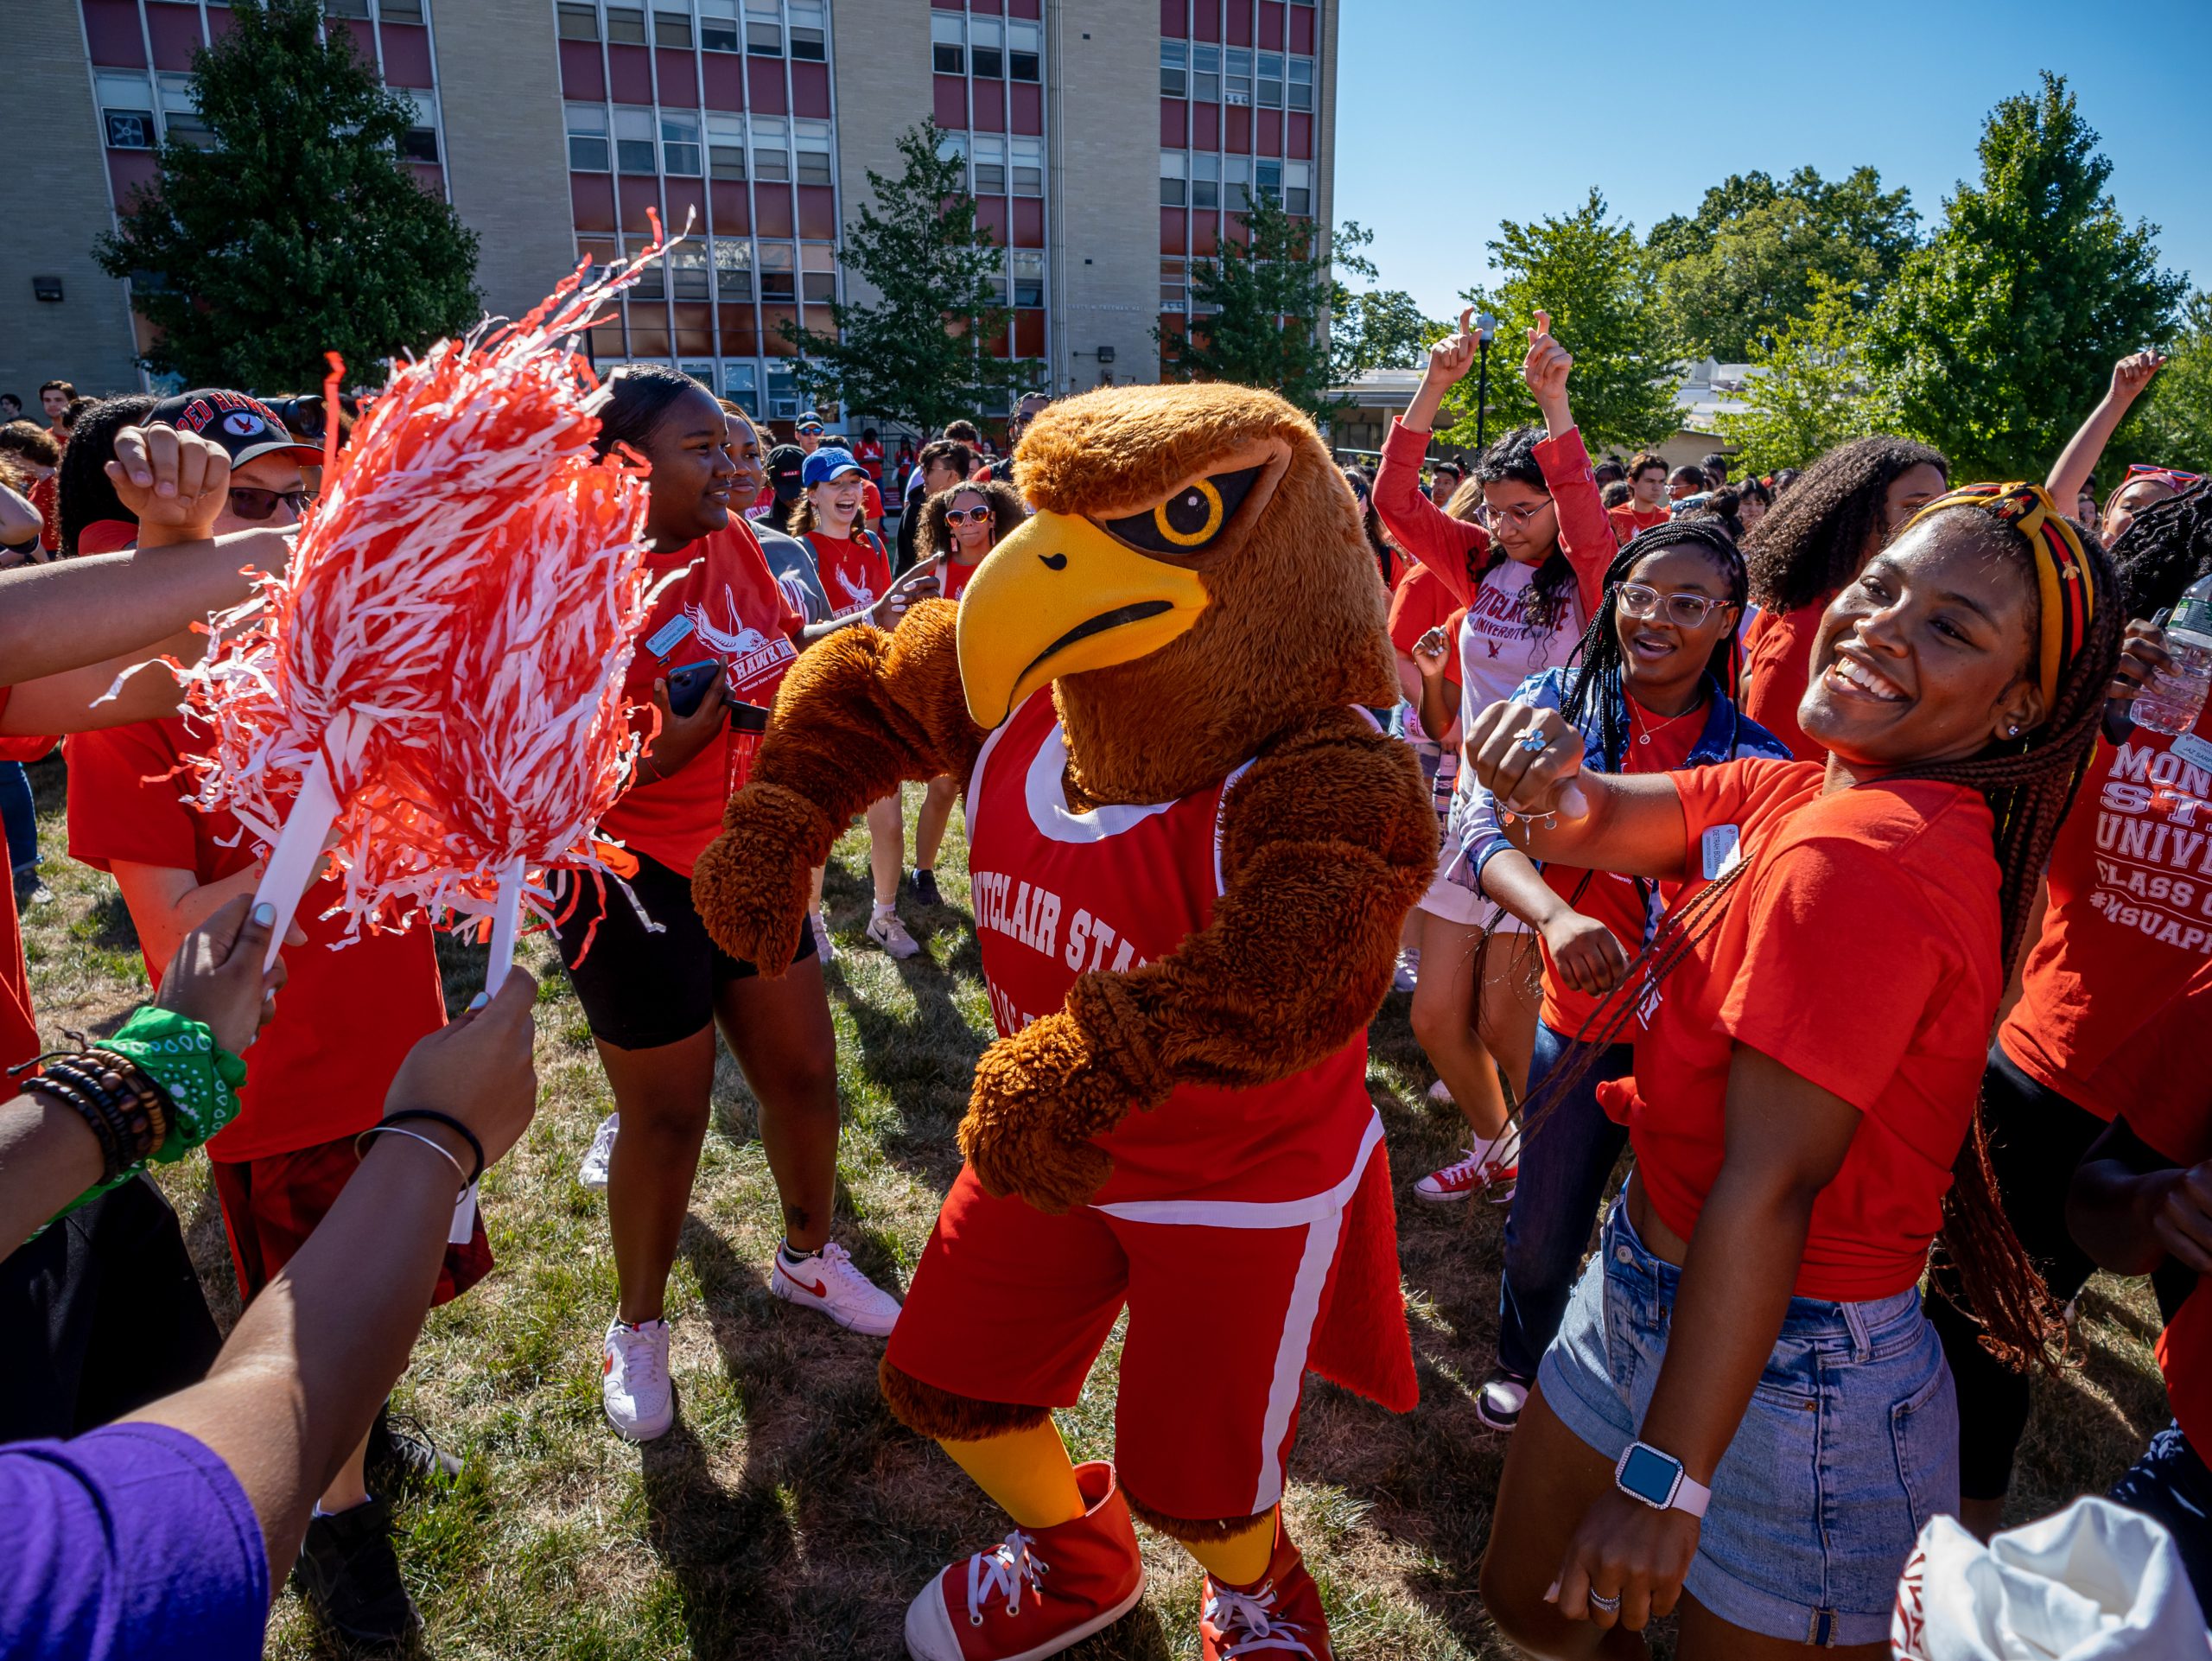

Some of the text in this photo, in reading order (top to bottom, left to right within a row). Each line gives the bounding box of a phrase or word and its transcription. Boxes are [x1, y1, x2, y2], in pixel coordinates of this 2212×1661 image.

[175, 399, 213, 434] RED
[834, 608, 852, 620] RED
[733, 646, 779, 680] HAWK
[2108, 742, 2211, 799] MON
[2100, 781, 2212, 831] ST
[971, 871, 1147, 974] NTCLAIR STA
